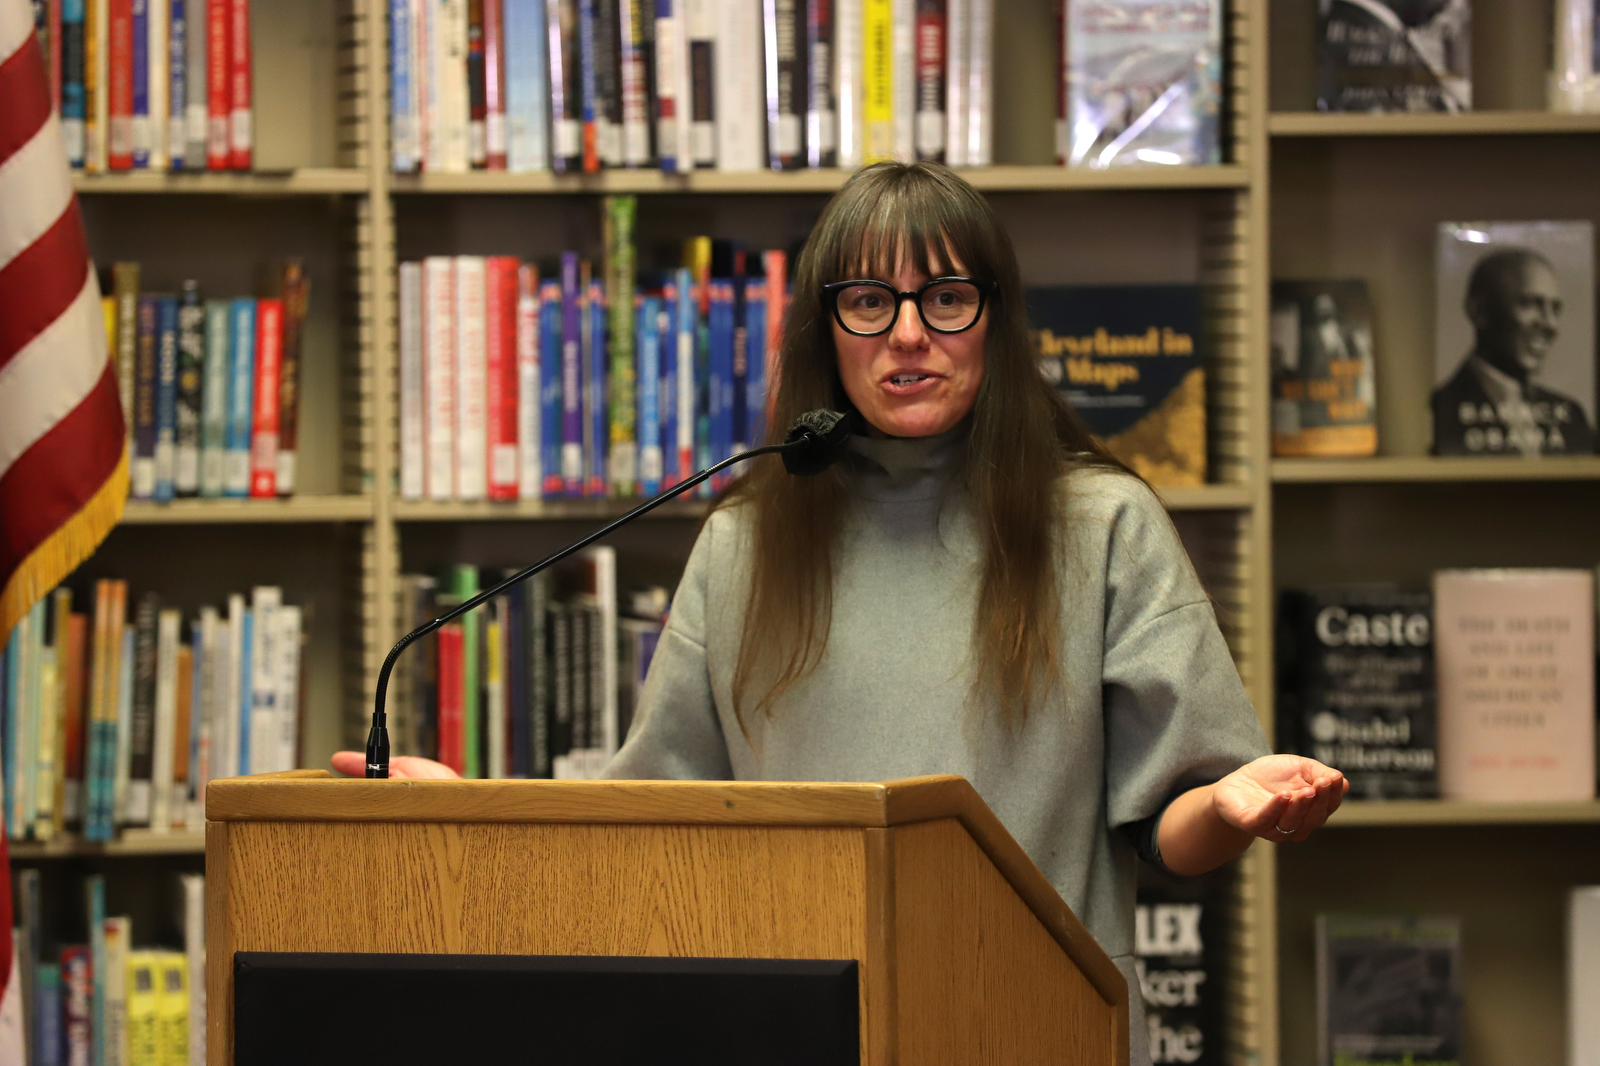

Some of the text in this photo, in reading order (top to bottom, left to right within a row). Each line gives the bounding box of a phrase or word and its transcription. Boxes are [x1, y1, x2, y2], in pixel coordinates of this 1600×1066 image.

[1162, 327, 1194, 356] in
[1064, 357, 1140, 391] Maps
[1458, 402, 1570, 425] BARACK
[1463, 427, 1566, 452] OBAMA
[1315, 606, 1430, 647] Caste
[1337, 715, 1410, 745] Isabel
[1313, 744, 1435, 773] Wilkerson
